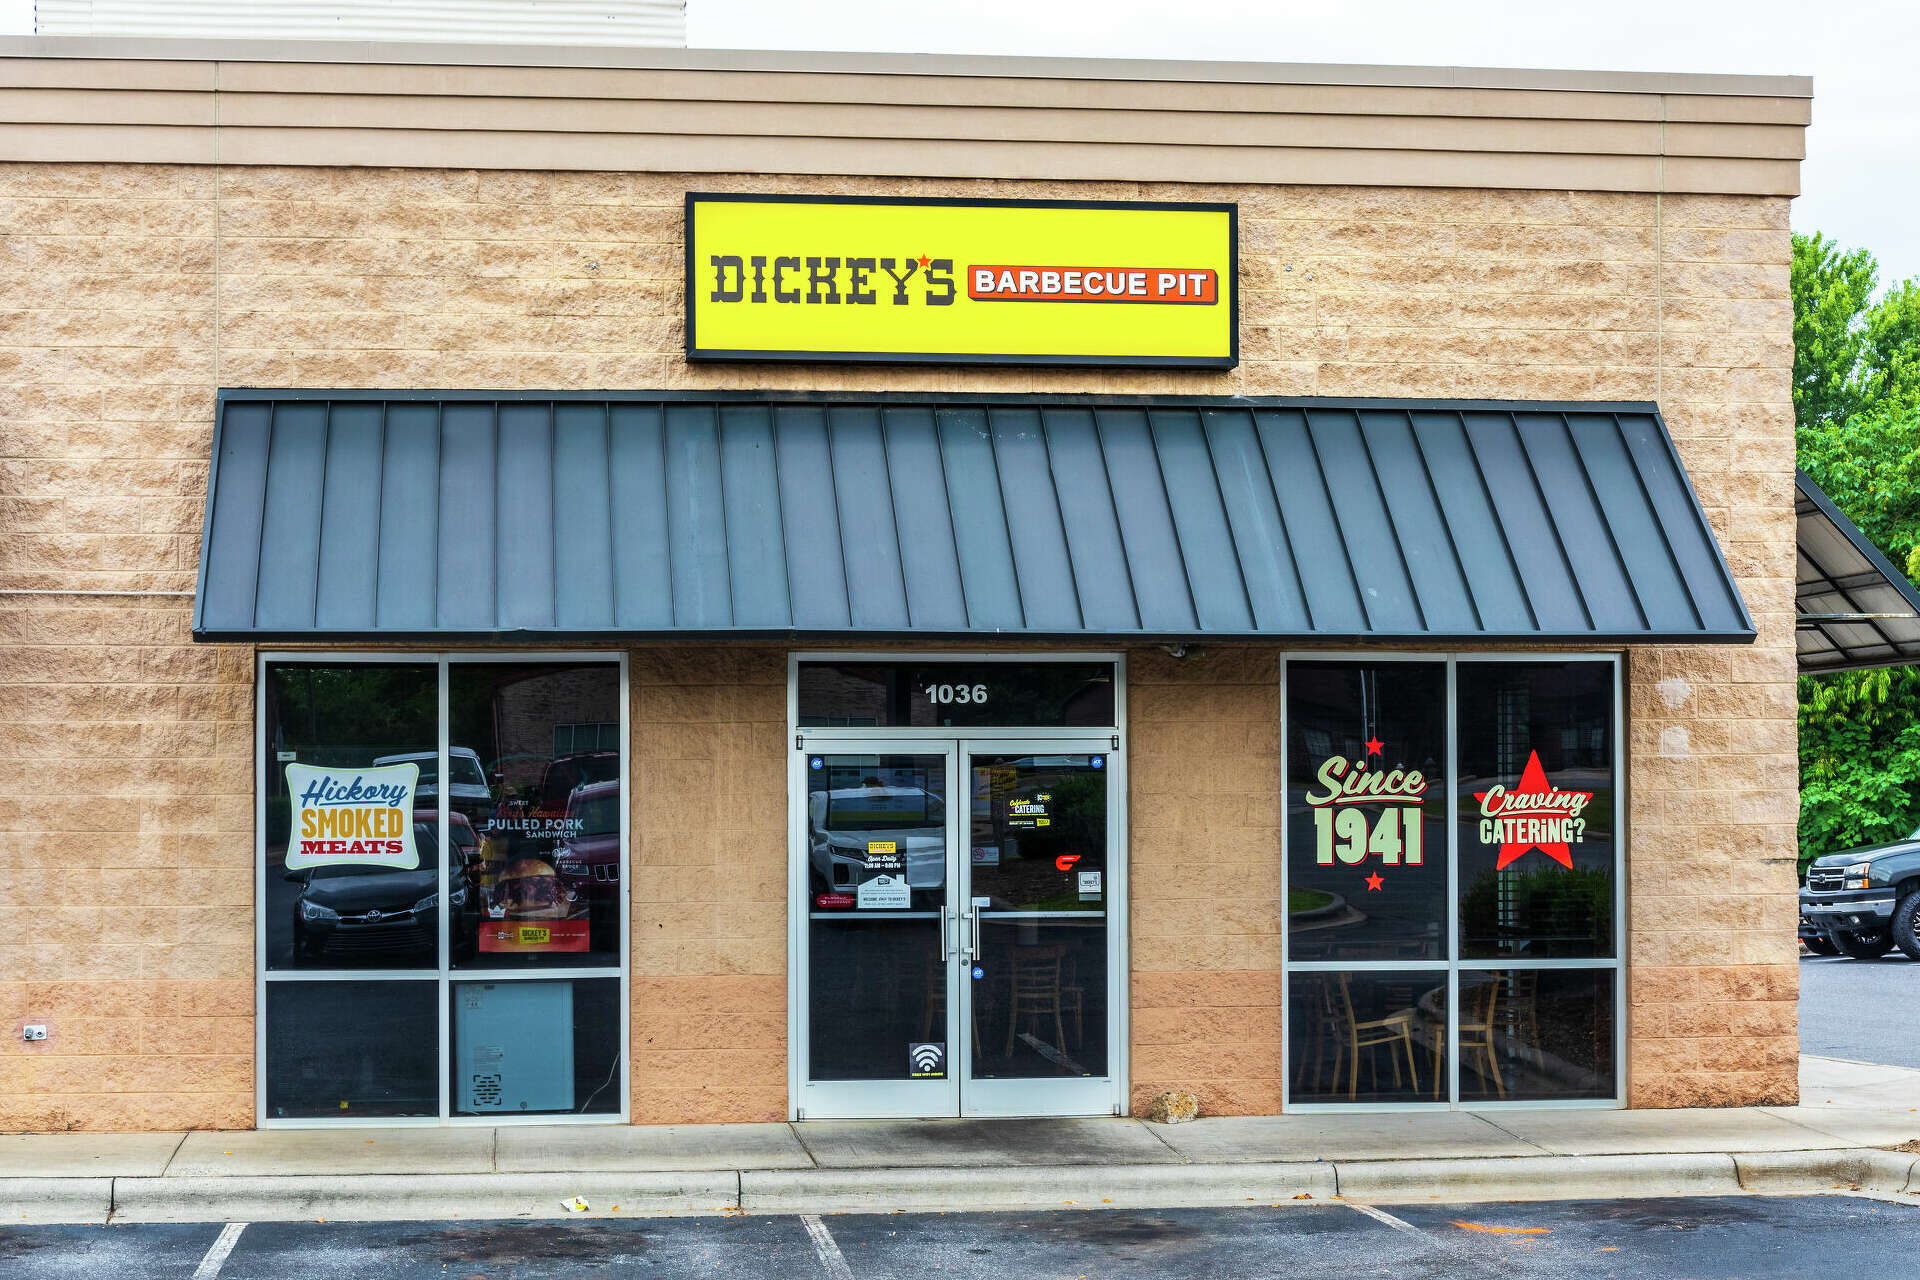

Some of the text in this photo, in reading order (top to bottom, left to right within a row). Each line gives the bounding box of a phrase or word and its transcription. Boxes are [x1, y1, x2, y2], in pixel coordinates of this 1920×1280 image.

[710, 254, 1209, 306] DICKEY'S BARBECUE PIT
[925, 684, 988, 704] 1036
[301, 776, 407, 808] Hickory
[1305, 755, 1426, 806] Since
[1014, 804, 1045, 814] CATERING
[1480, 784, 1589, 817] Craving
[301, 808, 403, 839] SMOKED
[487, 818, 584, 830] PULLED PORK
[525, 830, 577, 839] SANDWICH
[1314, 807, 1424, 866] 1941
[300, 840, 403, 855] MEATS
